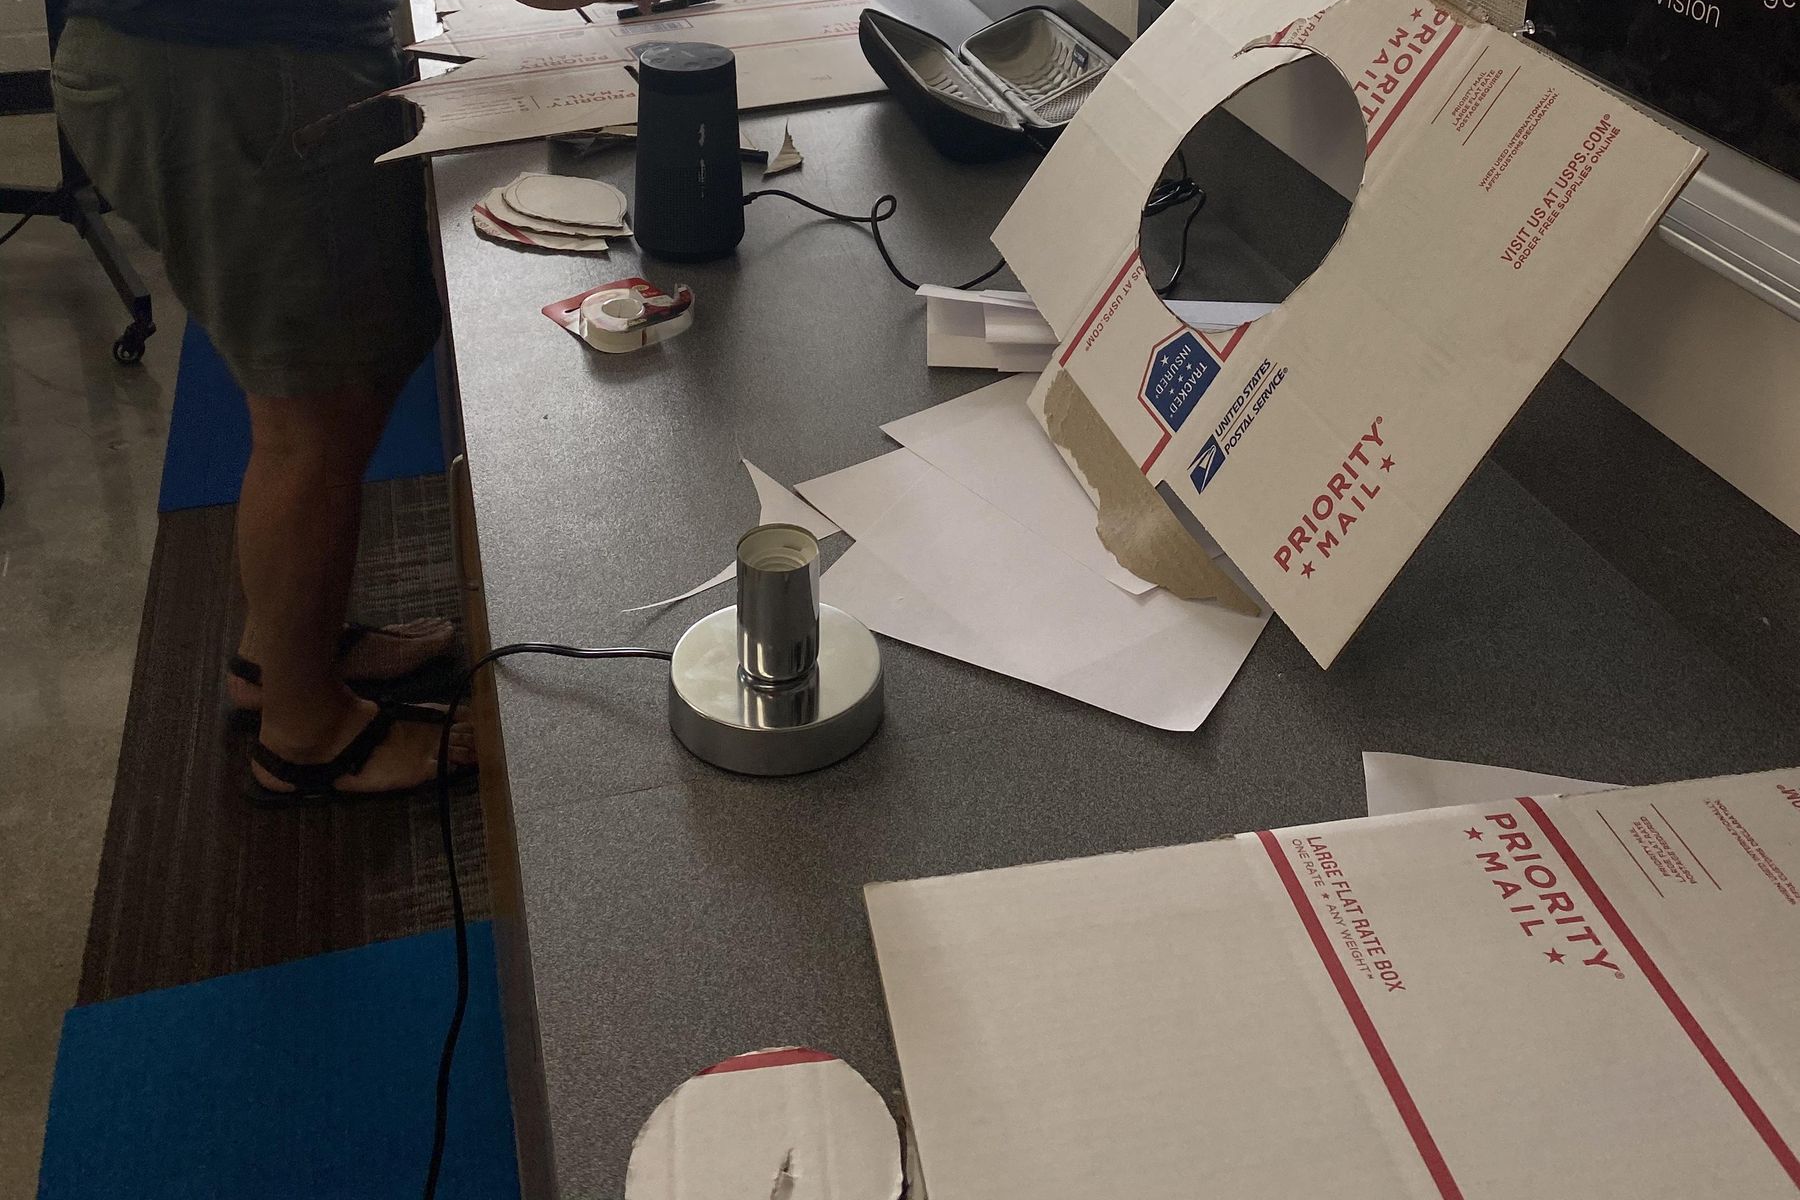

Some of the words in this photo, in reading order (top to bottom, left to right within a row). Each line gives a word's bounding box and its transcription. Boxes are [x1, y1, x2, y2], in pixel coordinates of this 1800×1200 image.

[1352, 27, 1410, 94] MAIL
[1451, 85, 1475, 117] PRIORITY
[1472, 71, 1487, 87] MAIL
[1451, 103, 1471, 127] LARGE
[1467, 86, 1483, 105] FLAT
[1479, 69, 1496, 88] RATE
[1455, 101, 1481, 133] POSTAGE
[1477, 69, 1504, 102] REQUIRED
[1478, 166, 1497, 187] WHEN
[1493, 148, 1509, 167] USED
[1485, 171, 1502, 193] AFFIX
[1499, 139, 1525, 172] CUSTOMS
[1513, 235, 1542, 270] ORDER
[1537, 209, 1561, 237] FREE
[1557, 164, 1593, 210] SUPPLIES
[1590, 126, 1621, 164] ONLINE
[1499, 226, 1531, 262] VISIT
[1526, 207, 1547, 228] US
[1542, 187, 1559, 209] AT
[1122, 279, 1132, 297] AT
[1214, 395, 1245, 437] UNITED
[1242, 357, 1271, 399] STATES
[1220, 413, 1255, 456] POSTAL
[1315, 483, 1381, 559] MAIL
[1291, 838, 1311, 860] ONE
[1303, 860, 1326, 888] RATE
[1325, 903, 1347, 927] ANY
[1306, 836, 1344, 879] LARGE
[1331, 880, 1364, 915] FLAT
[1351, 912, 1387, 957] RATE
[1373, 959, 1407, 993] BOX
[1475, 851, 1545, 937] MAIL
